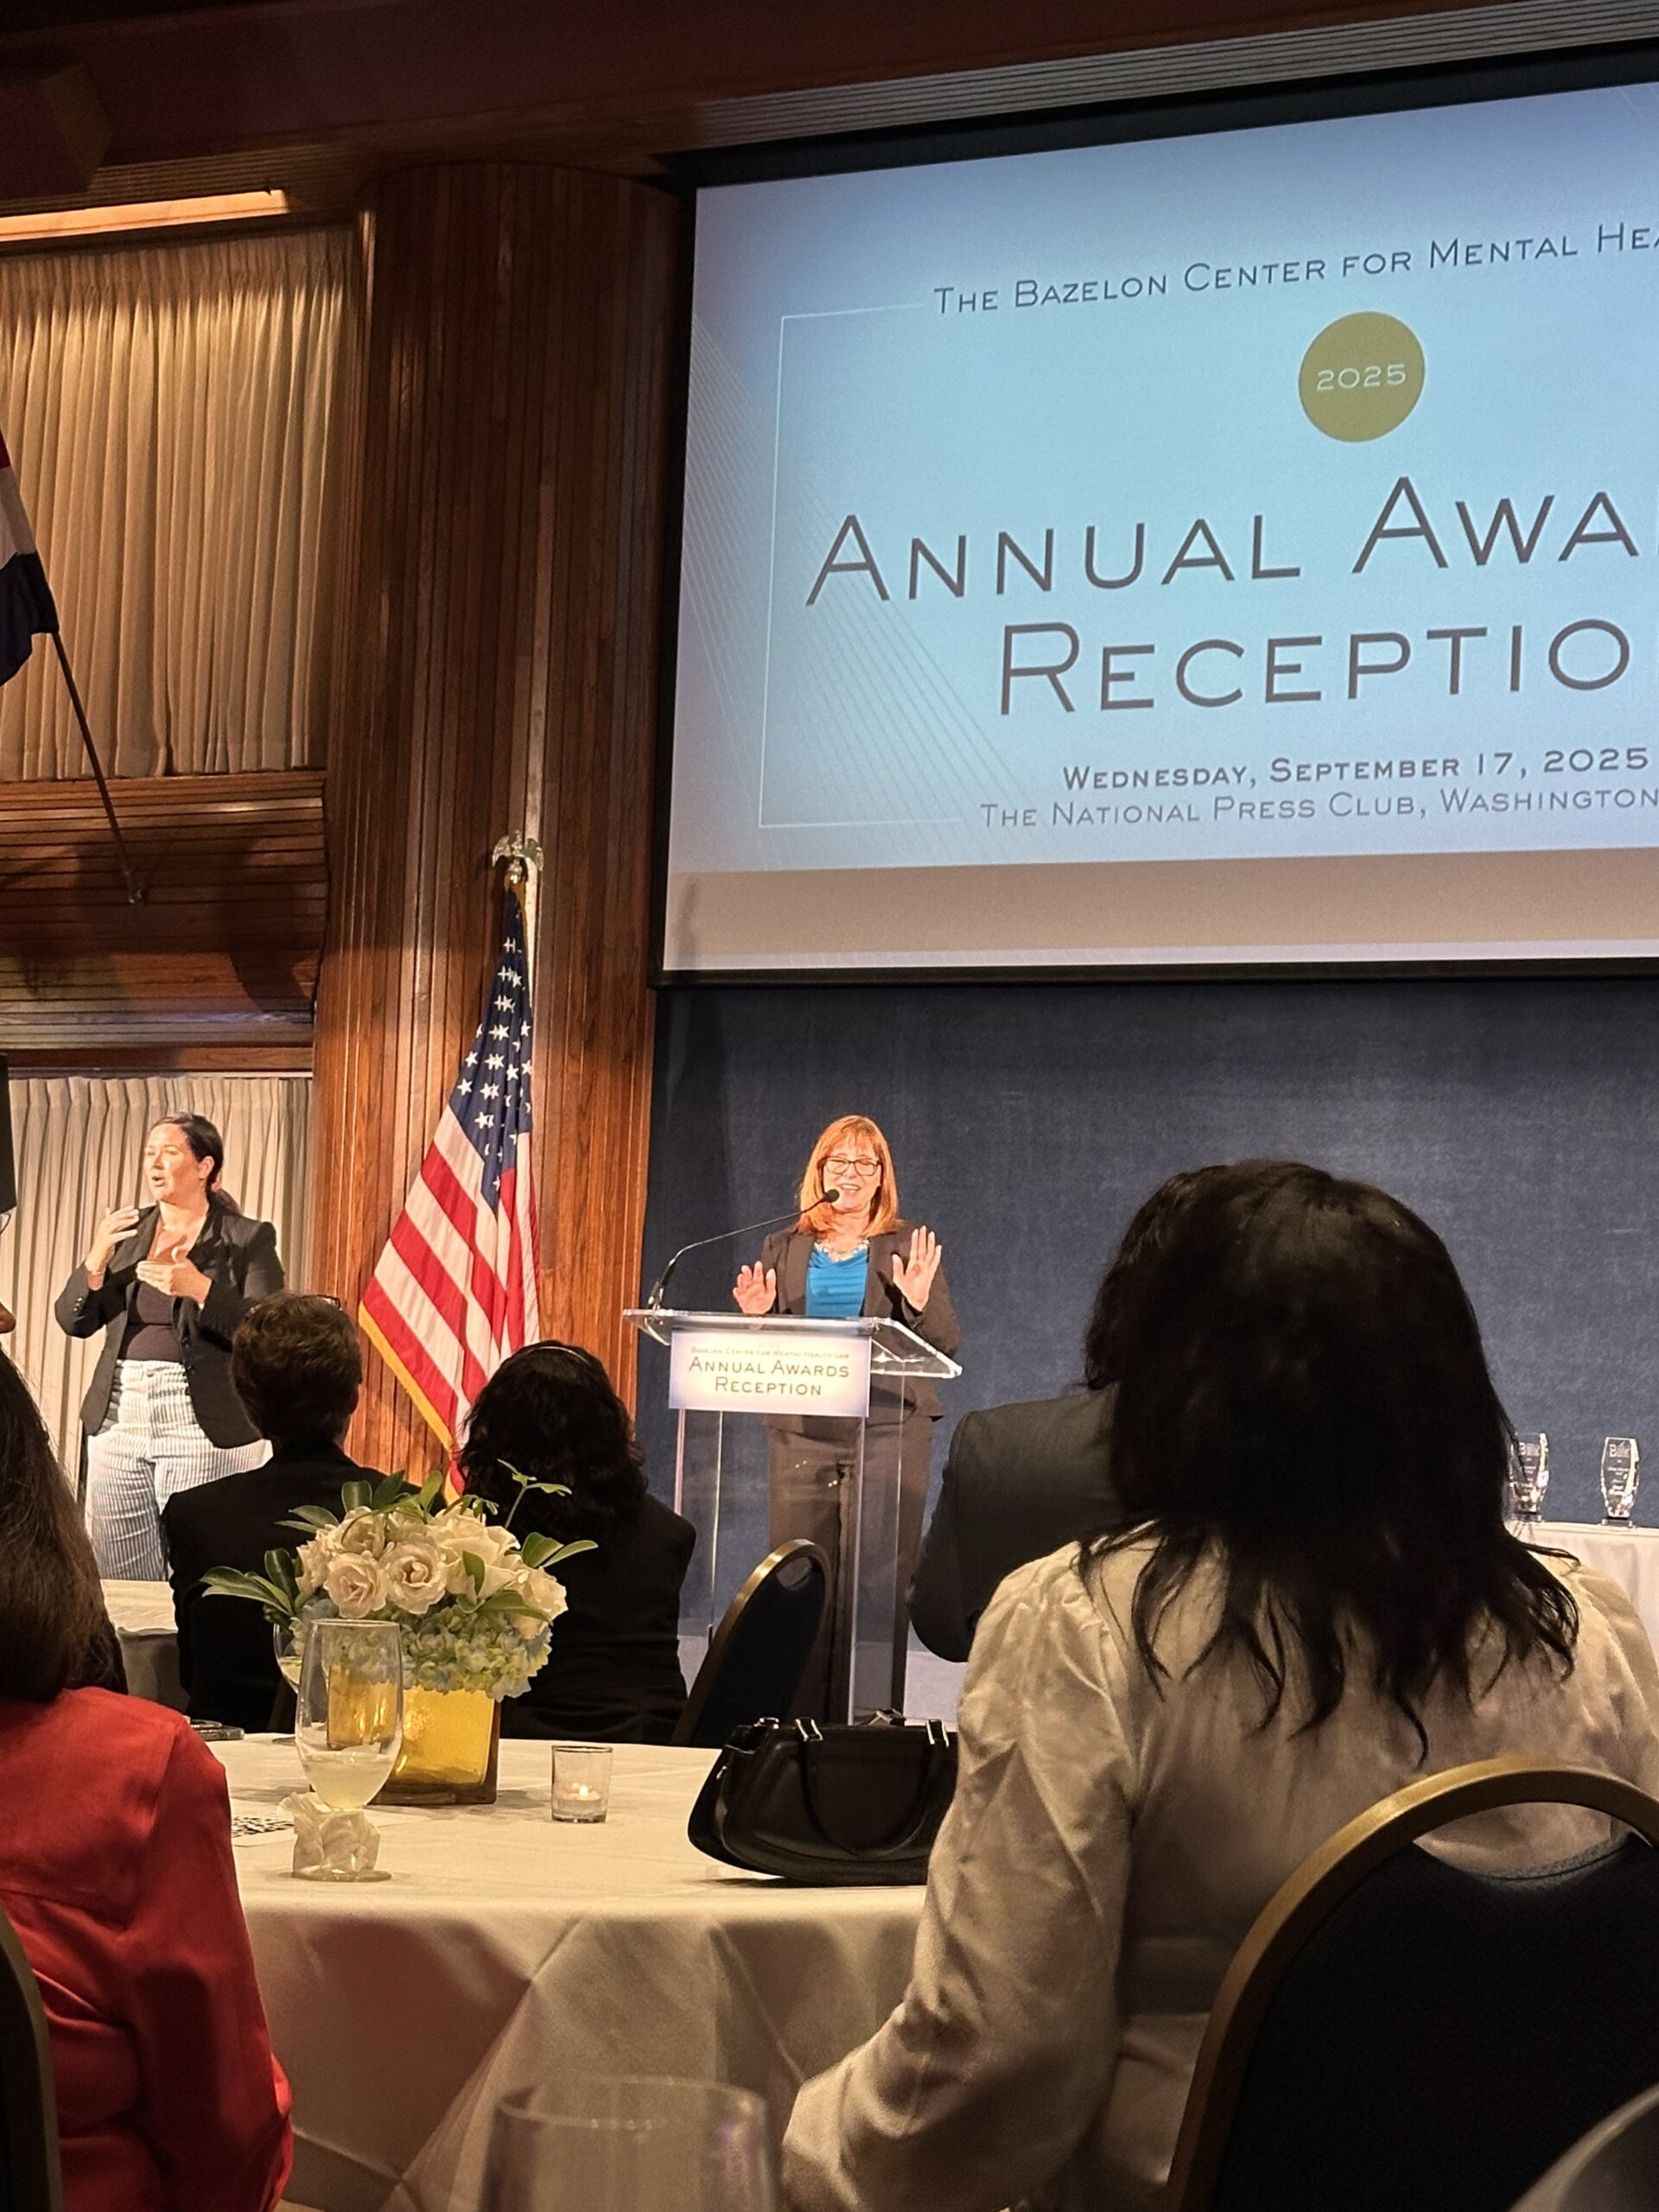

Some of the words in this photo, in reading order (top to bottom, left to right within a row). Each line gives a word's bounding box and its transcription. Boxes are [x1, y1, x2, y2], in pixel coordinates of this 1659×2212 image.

[933, 286, 999, 315] THE
[1014, 274, 1166, 308] BAZELON
[1184, 259, 1326, 292] CENTER
[1342, 251, 1412, 277] FOR
[1429, 235, 1579, 270] MENTAL
[1316, 363, 1407, 391] 2025
[805, 513, 1301, 607] ANNUAL
[1351, 476, 1659, 575] AWA
[1000, 619, 1630, 716] RECEPTIO
[1063, 765, 1257, 791] WEDNESDAY,
[1269, 757, 1460, 784] SEPTEMBER
[1477, 752, 1528, 779] 17,
[1543, 747, 1649, 774] 2025
[980, 804, 1039, 829] THE
[1052, 801, 1200, 827] NATIONAL
[1213, 795, 1316, 821] PRESS
[1328, 791, 1427, 819] CLUB,
[1440, 787, 1659, 814] WASHINGTON
[689, 1356, 765, 1375] ANNUAL
[771, 1359, 850, 1378] AWARDS
[715, 1376, 822, 1396] RECEPTION
